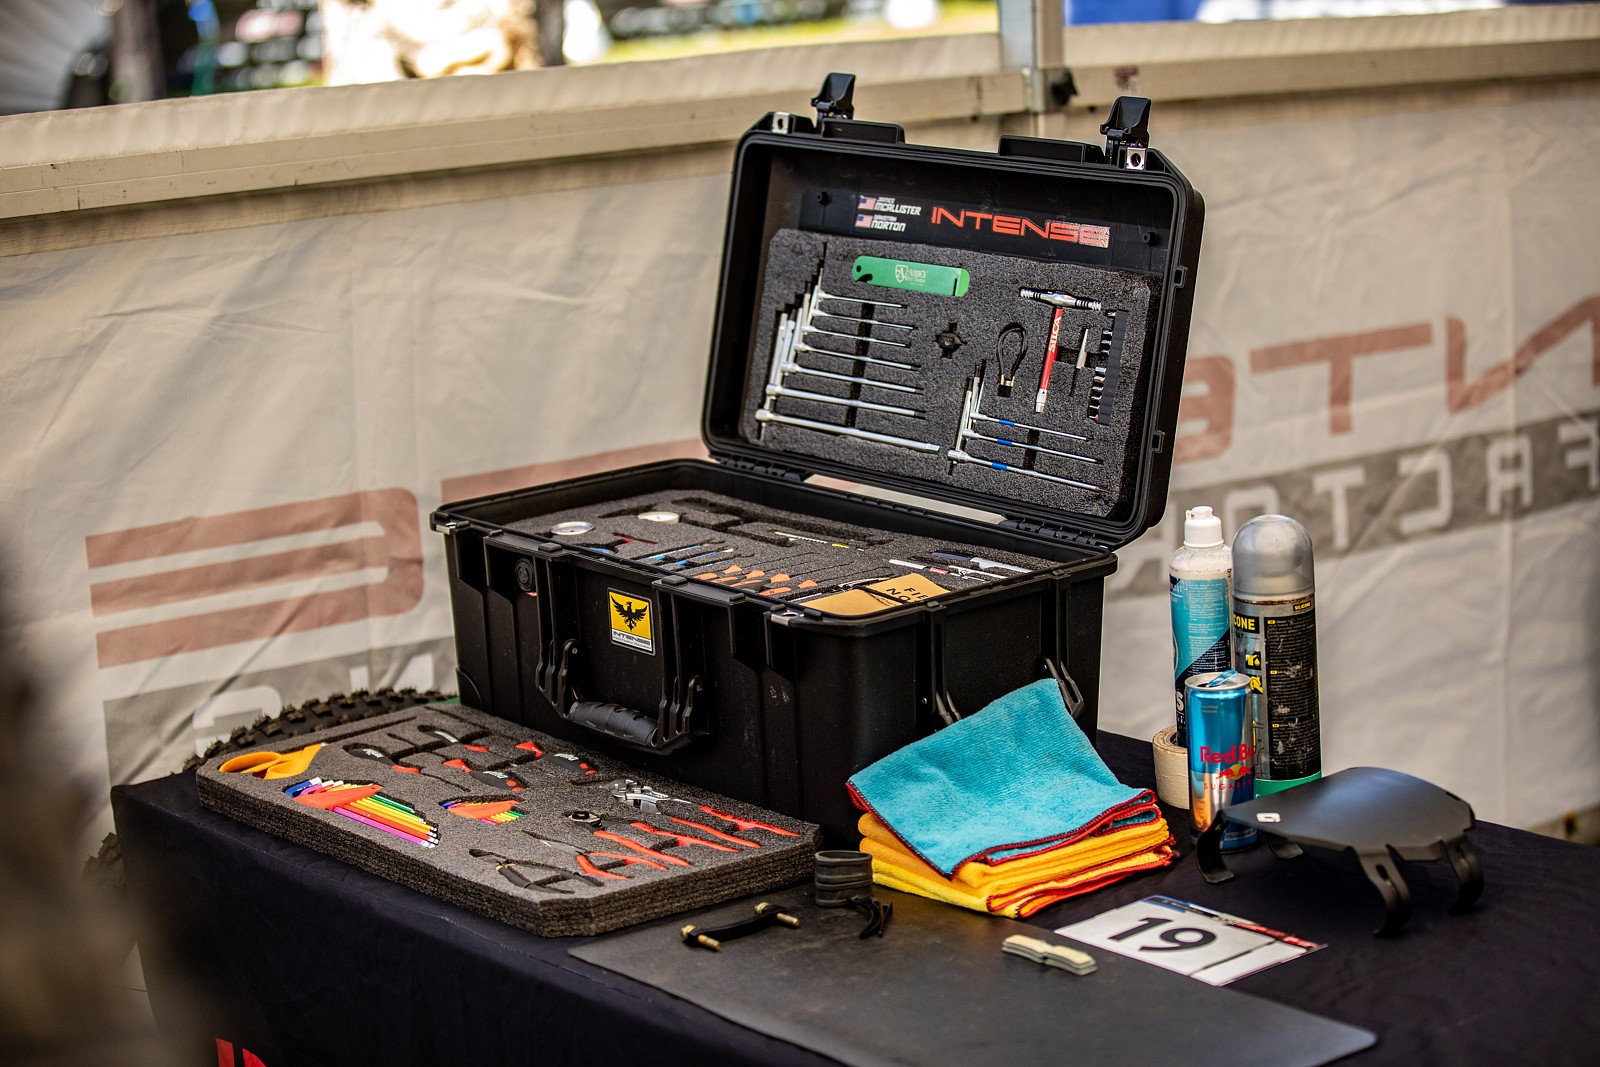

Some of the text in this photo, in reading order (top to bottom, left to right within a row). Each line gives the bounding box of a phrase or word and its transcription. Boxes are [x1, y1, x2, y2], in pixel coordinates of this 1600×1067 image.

[871, 220, 907, 232] NORTON
[931, 206, 1111, 249] INTENSE
[1048, 316, 1062, 353] SILCA
[886, 588, 911, 601] NO
[904, 587, 928, 600] FIE
[1199, 743, 1236, 764] Red
[1237, 742, 1255, 761] Bu
[1107, 917, 1217, 952] 19
